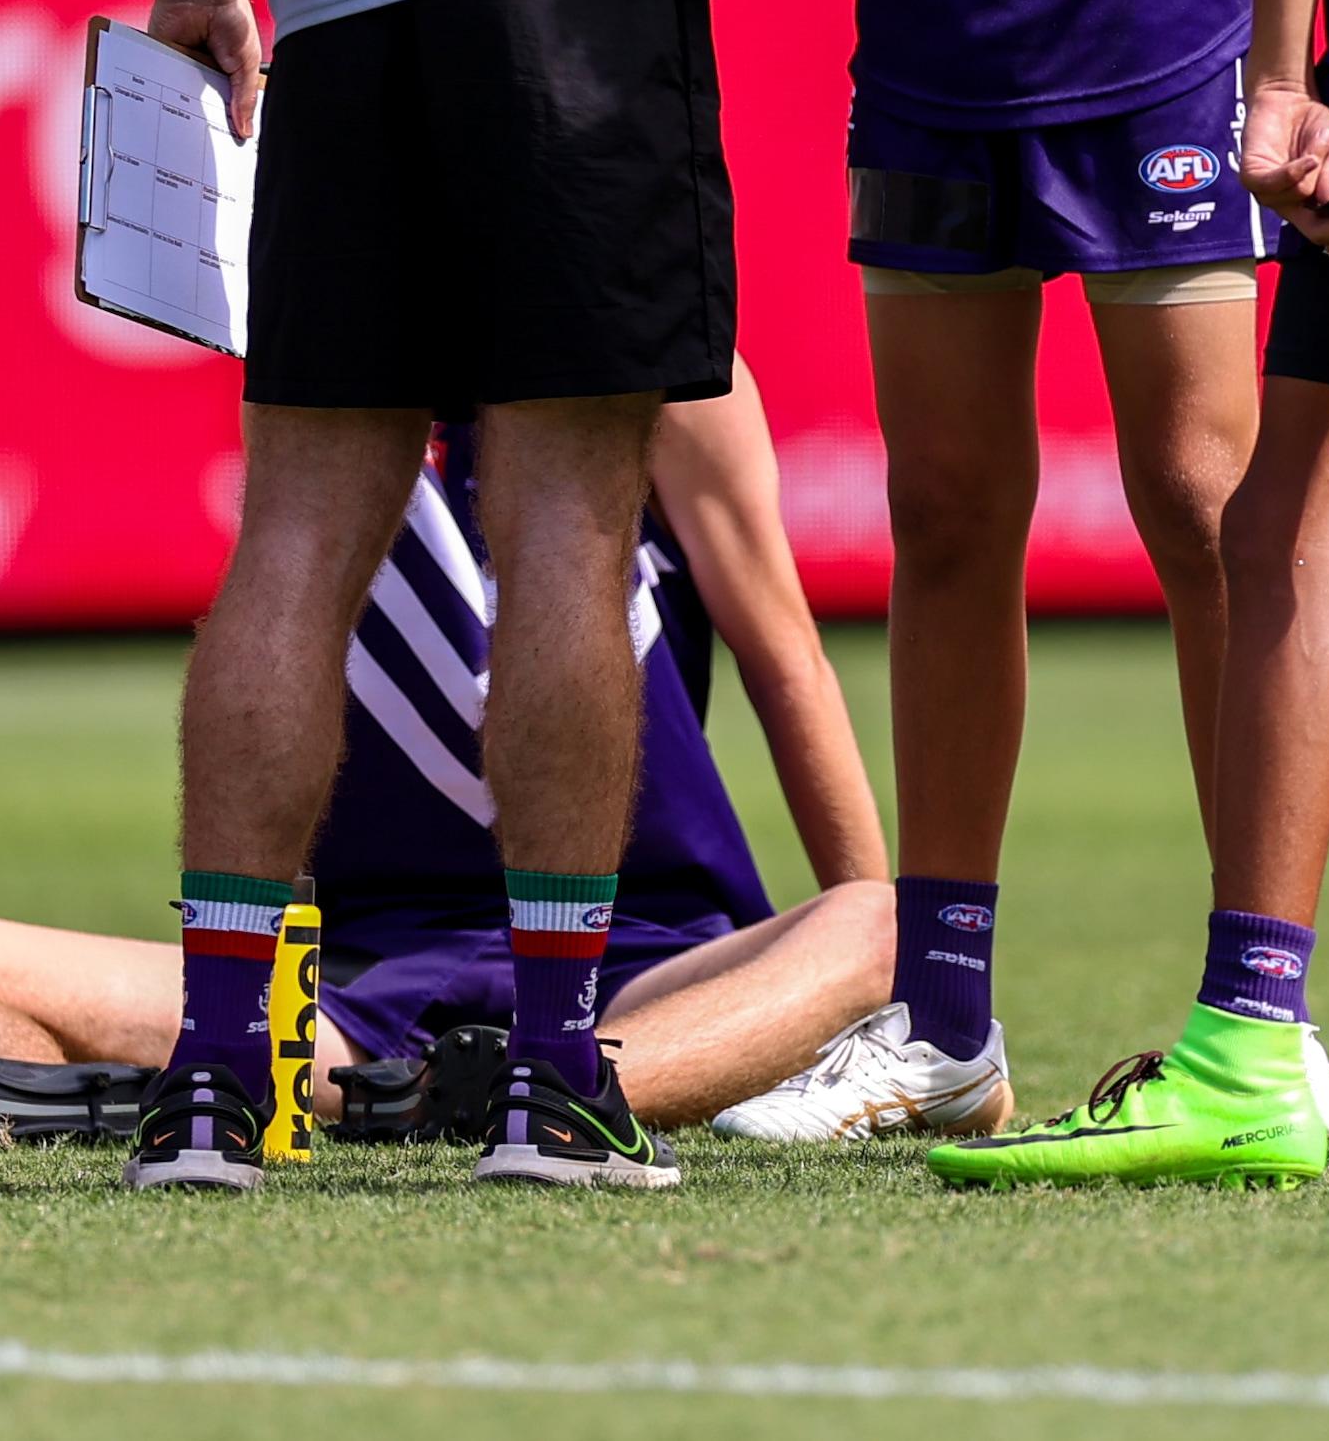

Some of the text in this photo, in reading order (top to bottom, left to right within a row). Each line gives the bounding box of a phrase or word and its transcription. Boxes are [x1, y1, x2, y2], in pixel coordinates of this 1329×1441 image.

[1148, 155, 1213, 183] AFL
[1148, 210, 1212, 224] Sekem
[1248, 954, 1299, 976] AFL
